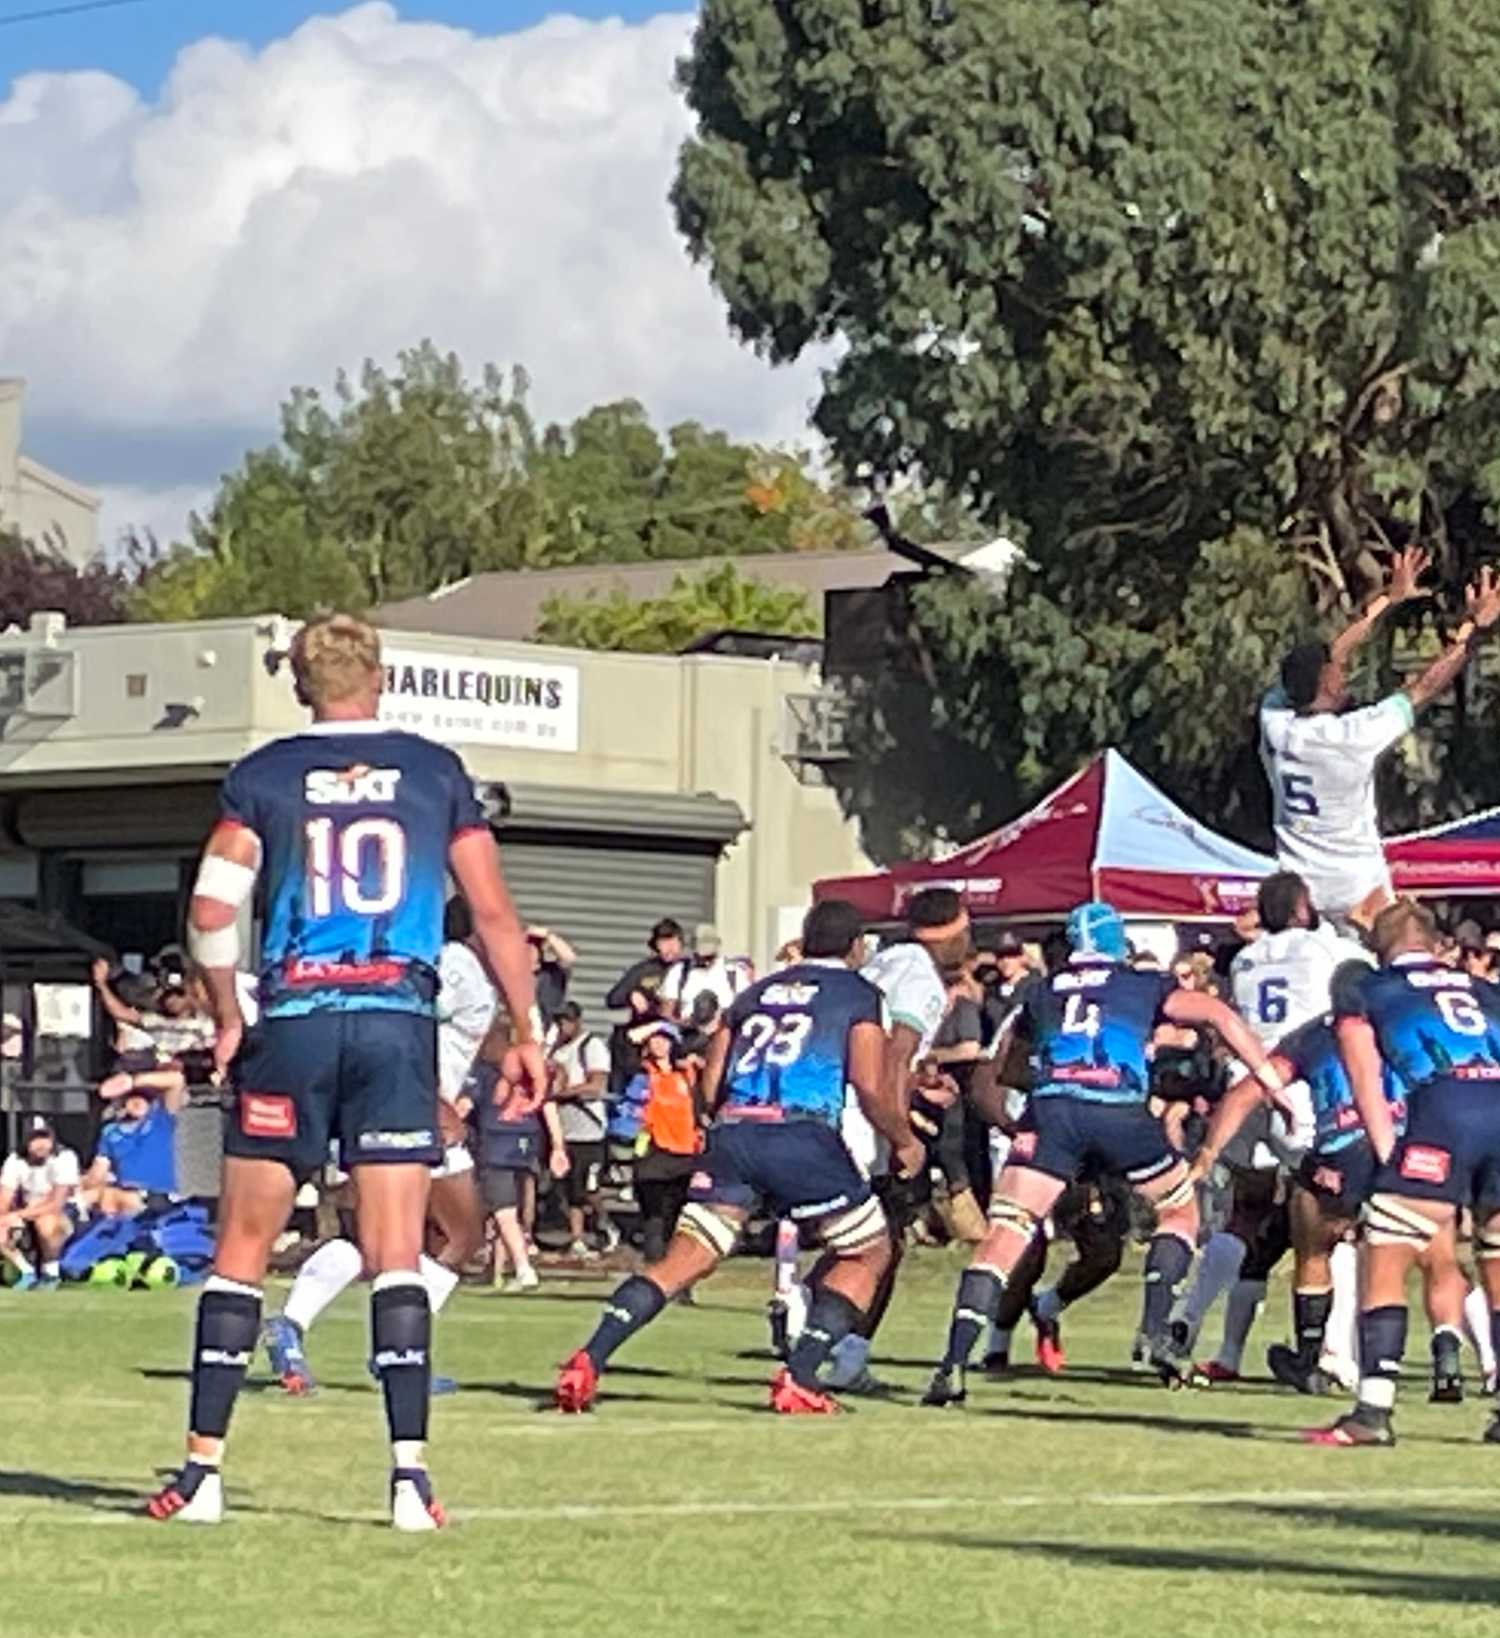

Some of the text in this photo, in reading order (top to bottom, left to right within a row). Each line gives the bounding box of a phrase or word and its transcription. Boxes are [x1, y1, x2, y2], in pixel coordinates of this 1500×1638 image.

[1281, 772, 1319, 816] 5
[305, 817, 405, 918] 10
[1061, 993, 1100, 1038] 4
[1257, 977, 1289, 1023] 6
[1434, 991, 1488, 1036] 6
[735, 1013, 814, 1073] 23
